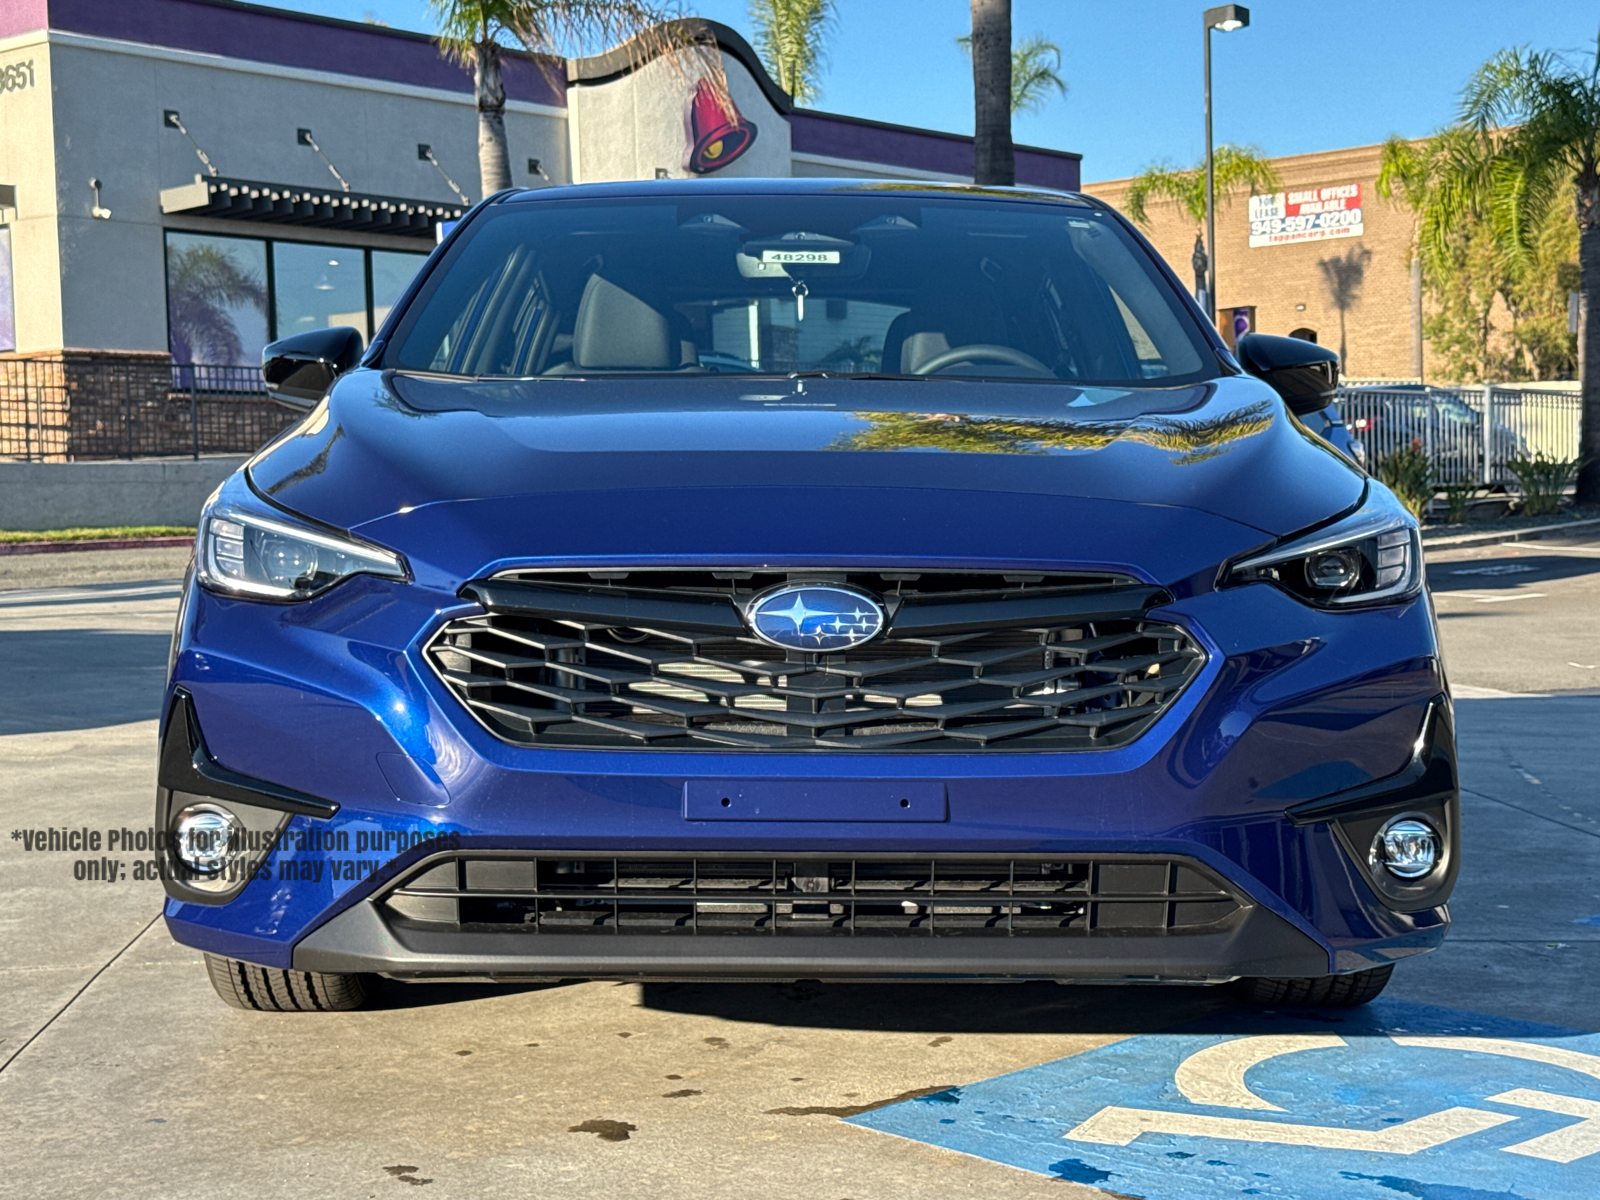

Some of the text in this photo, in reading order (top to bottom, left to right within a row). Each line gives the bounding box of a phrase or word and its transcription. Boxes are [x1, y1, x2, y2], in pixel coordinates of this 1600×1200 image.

[1287, 184, 1358, 205] SMALL OFFICES
[1254, 207, 1279, 219] LEASE
[1299, 199, 1347, 215] AVAILABLE
[1251, 208, 1362, 236] 949-597-0200
[771, 253, 828, 262] 48298
